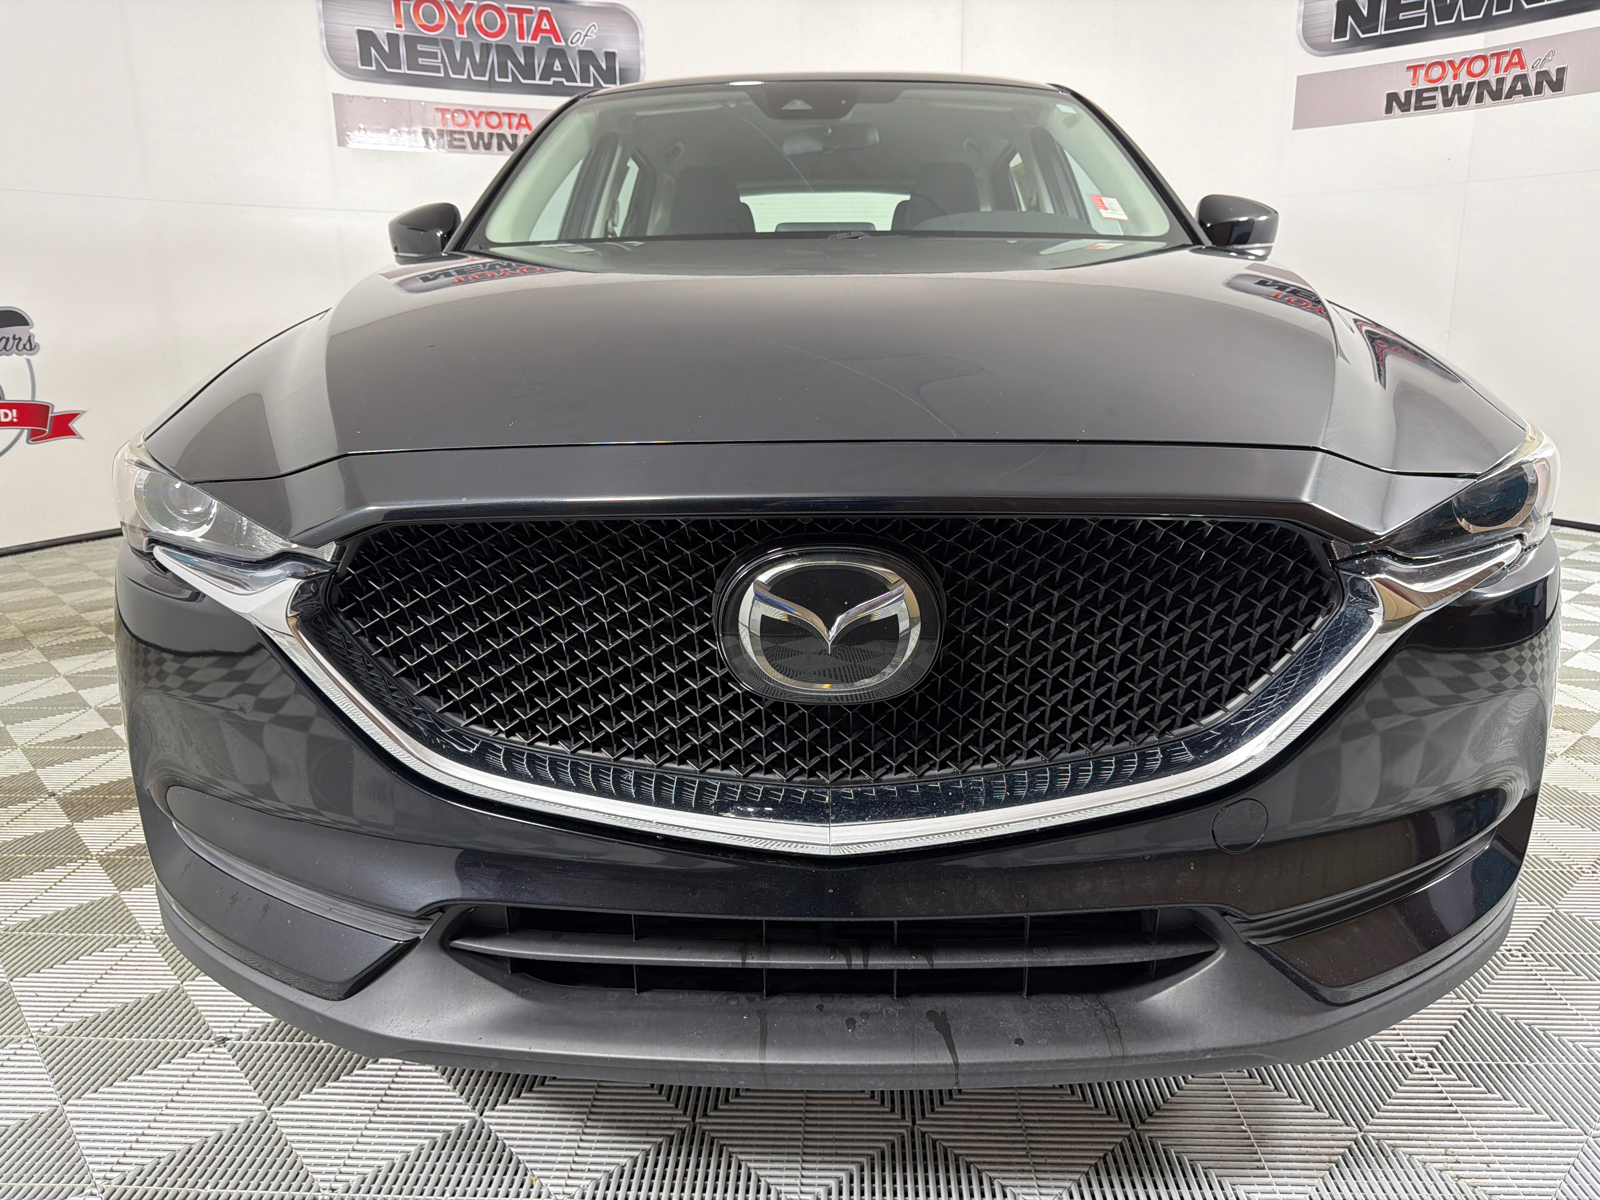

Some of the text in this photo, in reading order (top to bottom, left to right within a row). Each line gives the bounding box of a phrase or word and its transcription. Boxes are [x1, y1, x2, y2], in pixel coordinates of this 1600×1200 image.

[391, 0, 598, 47] TOYOTA of
[355, 28, 621, 87] NEWNAN
[1406, 47, 1556, 87] TOYOTA of
[1384, 66, 1568, 116] NEWNAN
[421, 127, 529, 152] NEWN
[434, 107, 533, 132] TOYOTA
